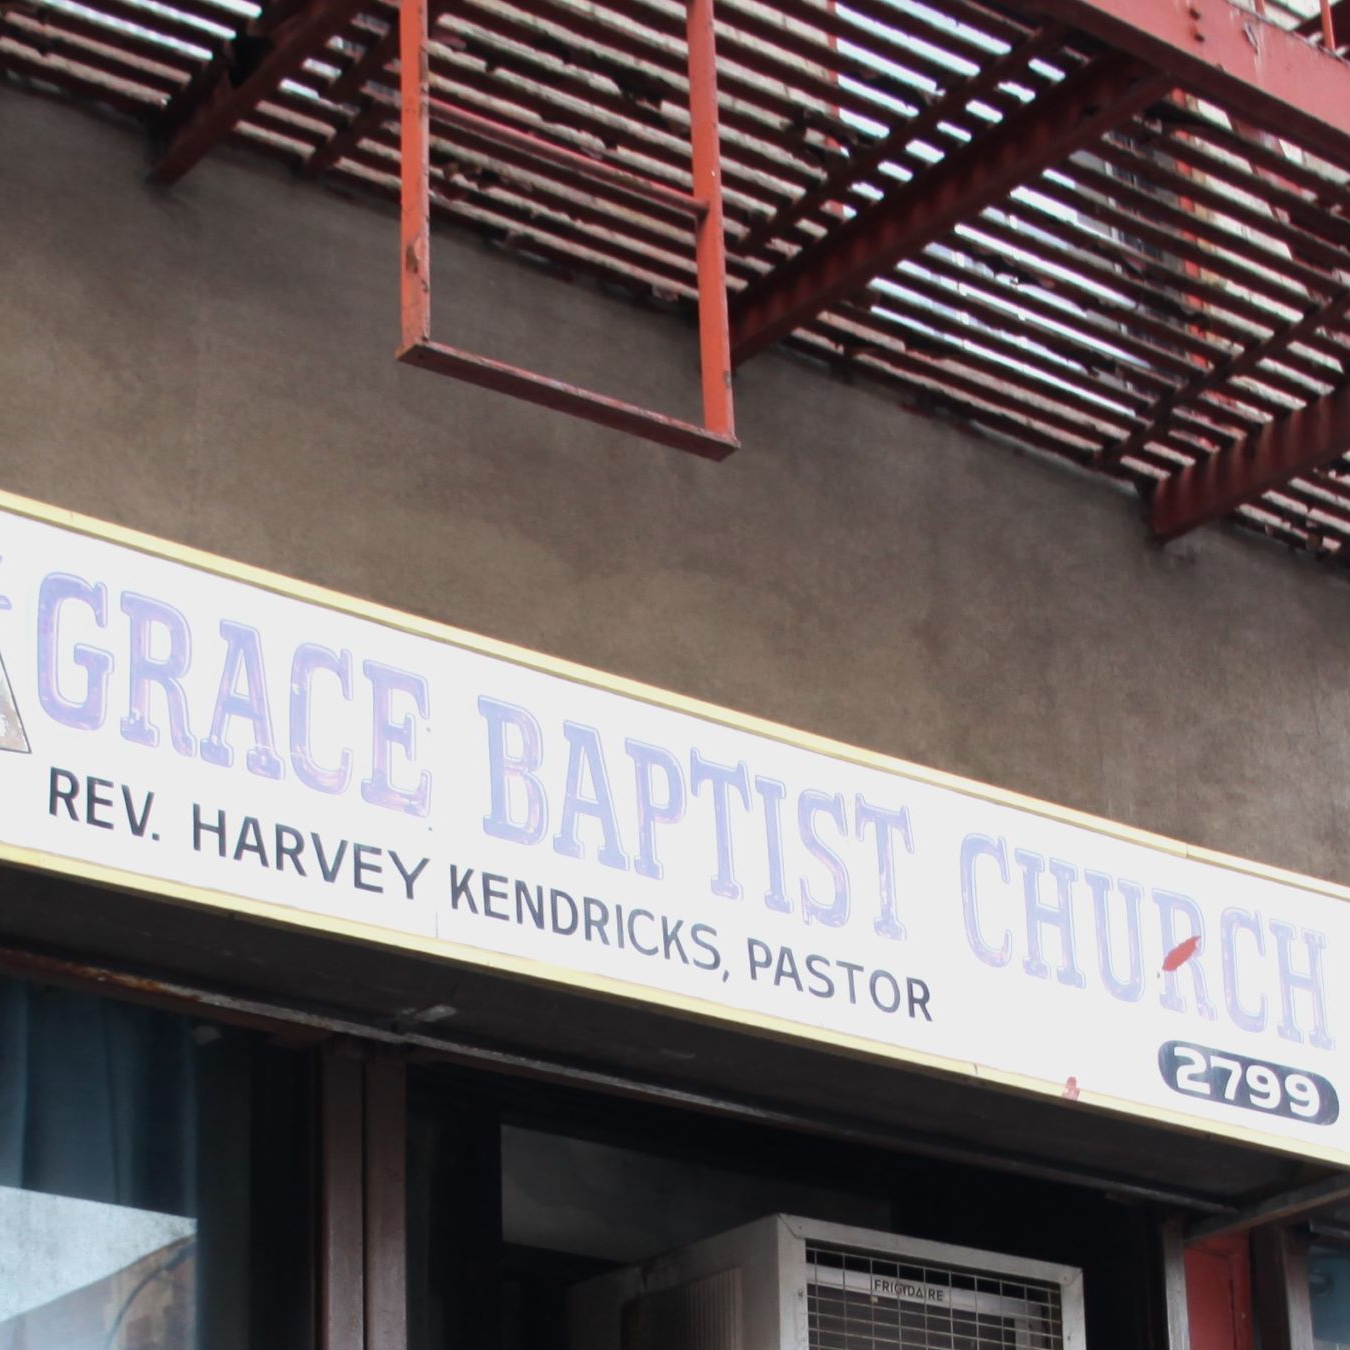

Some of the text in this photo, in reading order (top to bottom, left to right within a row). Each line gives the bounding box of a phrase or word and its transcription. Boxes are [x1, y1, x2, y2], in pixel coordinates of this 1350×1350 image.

[36, 571, 433, 818] GRACE
[477, 694, 915, 942] BAPTIST
[960, 833, 1336, 1051] CHURCH
[48, 766, 933, 1022] REV. HARVEY KENDRICKS, PASTOR
[1172, 1045, 1322, 1119] 2799
[874, 1279, 944, 1301] FRIGIDAIRE
